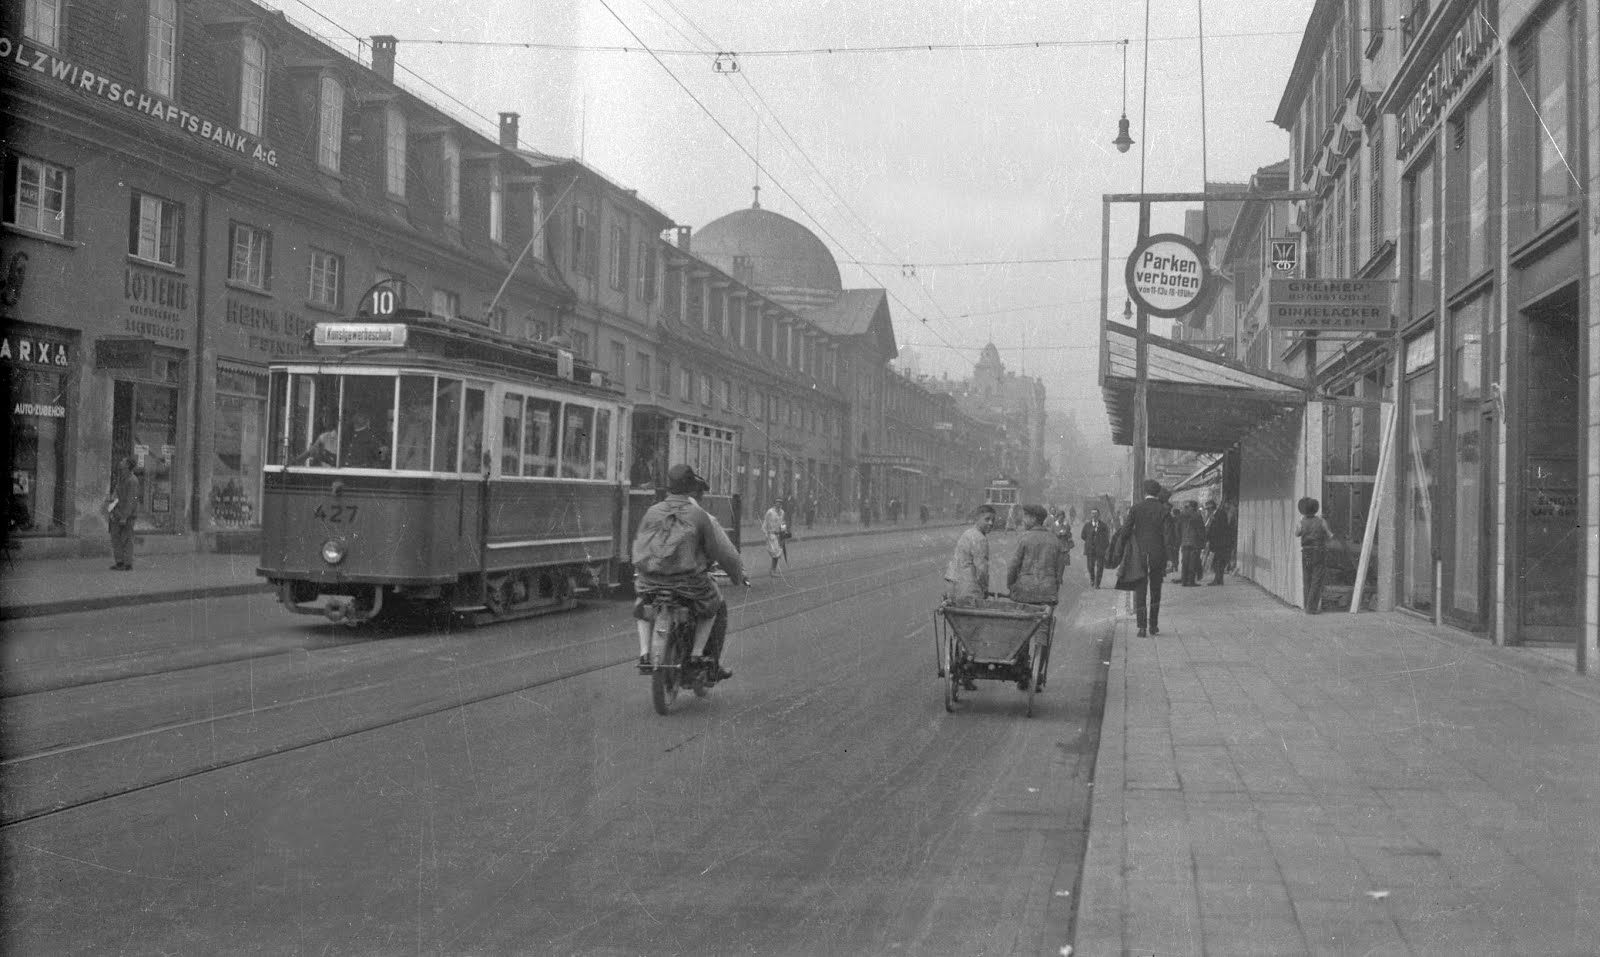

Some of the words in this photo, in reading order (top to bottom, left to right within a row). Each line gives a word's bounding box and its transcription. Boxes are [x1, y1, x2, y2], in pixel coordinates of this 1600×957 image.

[1143, 251, 1197, 273] Parken
[124, 269, 189, 310] LOTTERIE
[1136, 270, 1199, 289] verboten
[1287, 282, 1364, 293] GREINER
[372, 291, 394, 315] 10
[1278, 307, 1381, 317] DINKELACKER
[0, 337, 50, 363] ARX
[314, 505, 359, 523] 427
